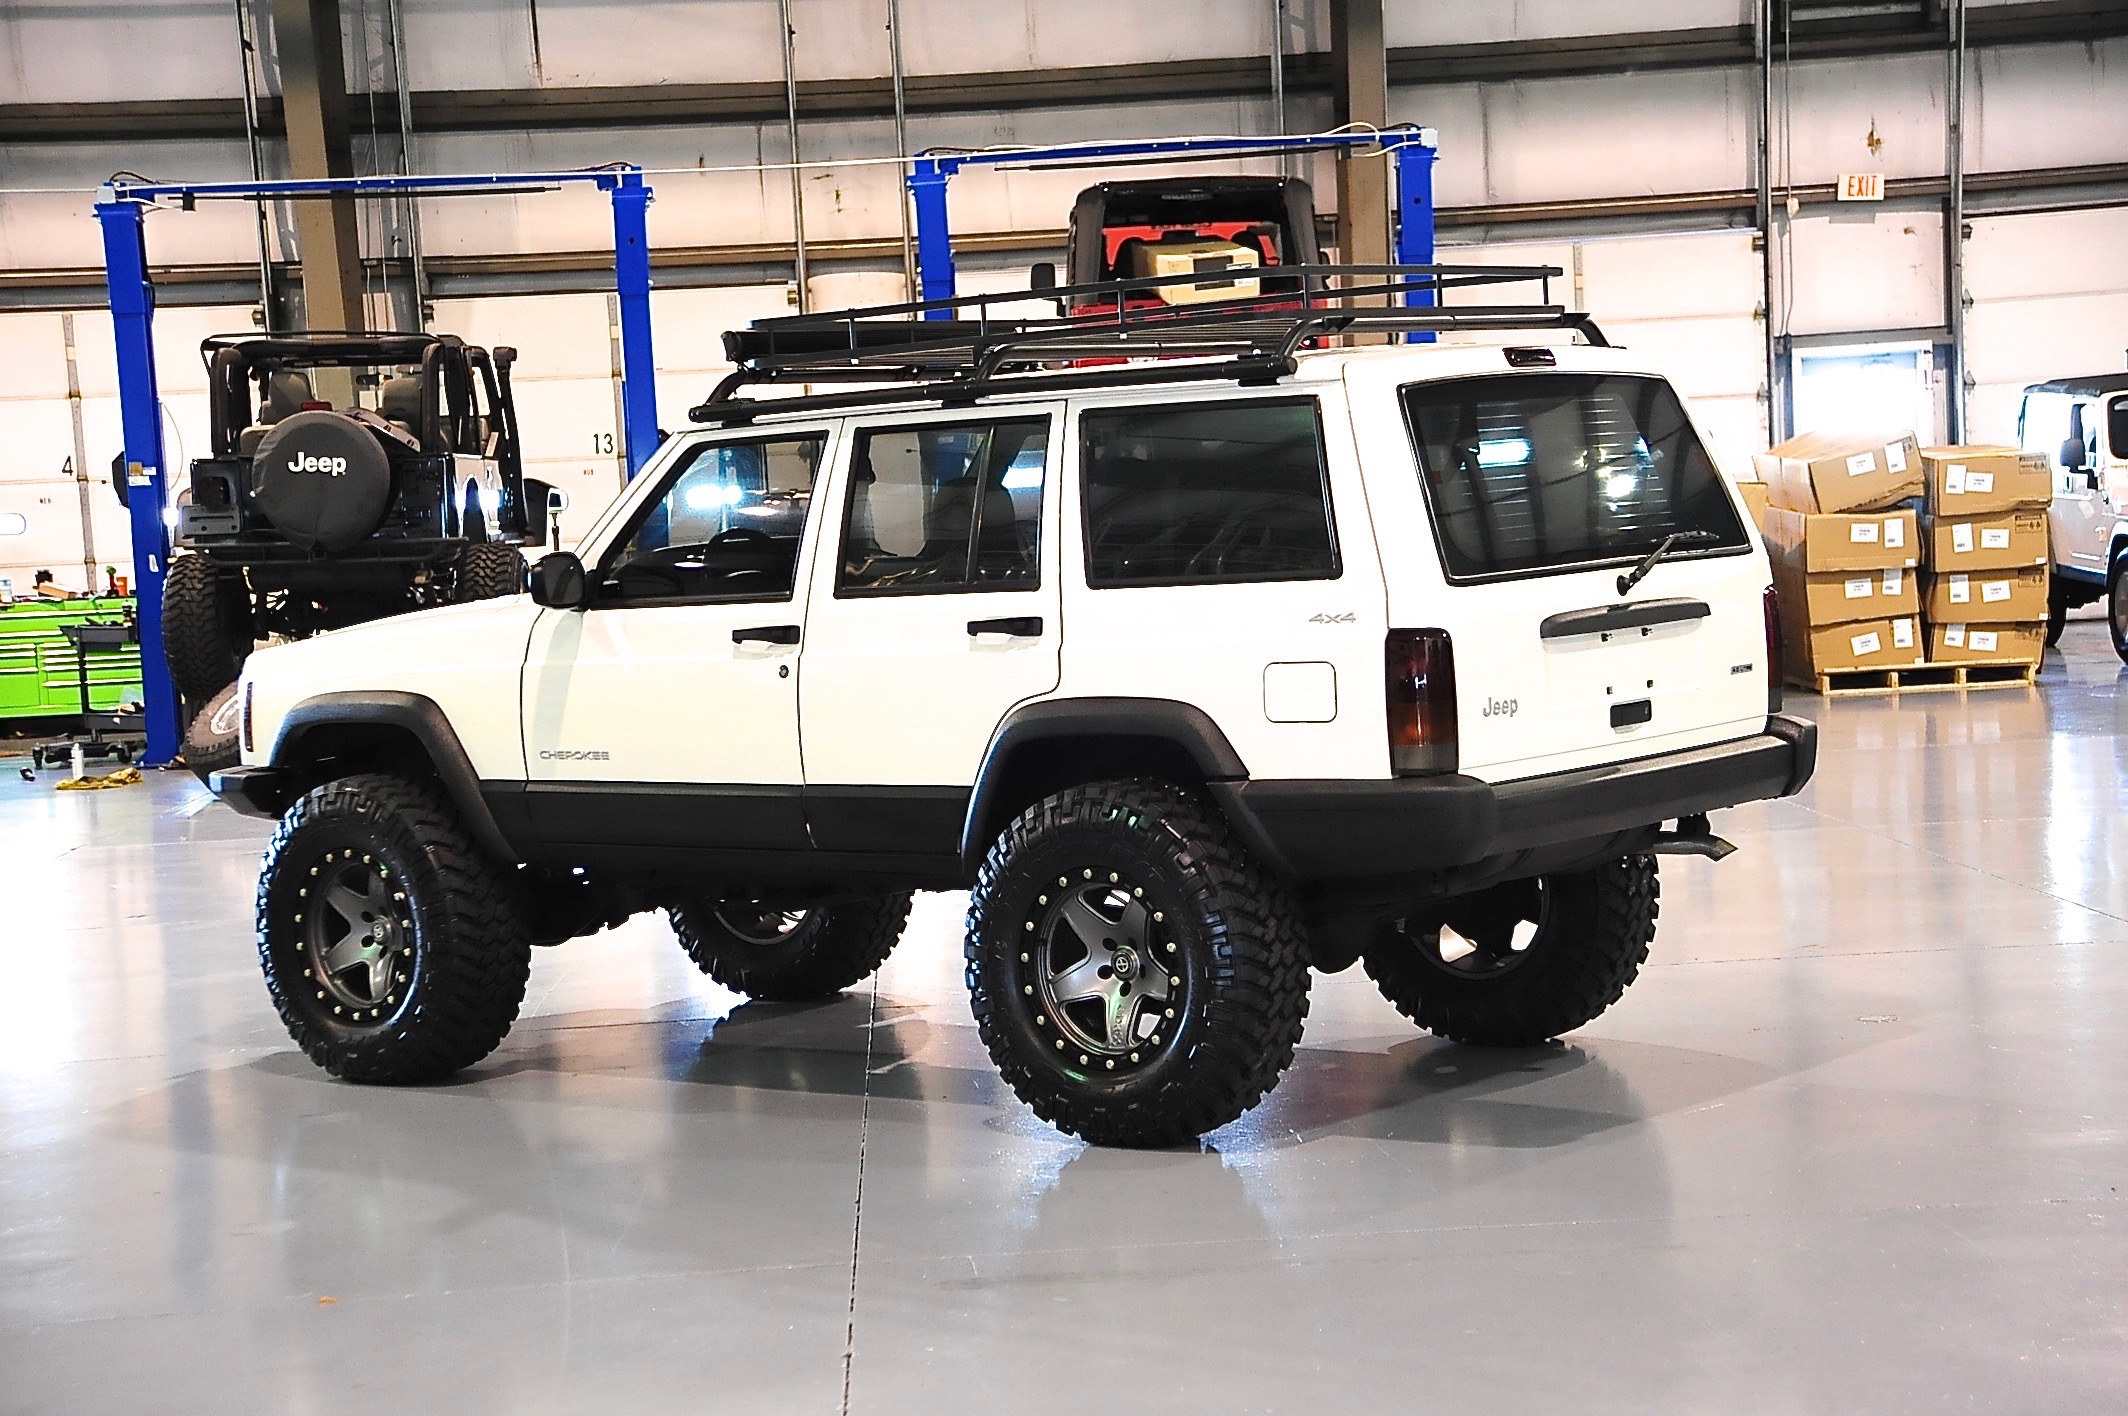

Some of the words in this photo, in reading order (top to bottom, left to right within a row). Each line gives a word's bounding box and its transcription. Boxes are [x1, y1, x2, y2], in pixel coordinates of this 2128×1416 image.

[1847, 175, 1878, 197] EXIT
[593, 432, 614, 455] 13
[61, 455, 74, 477] 4
[287, 451, 347, 477] Jeep
[1482, 696, 1519, 718] Jeep
[538, 750, 611, 761] CHEROKEE
